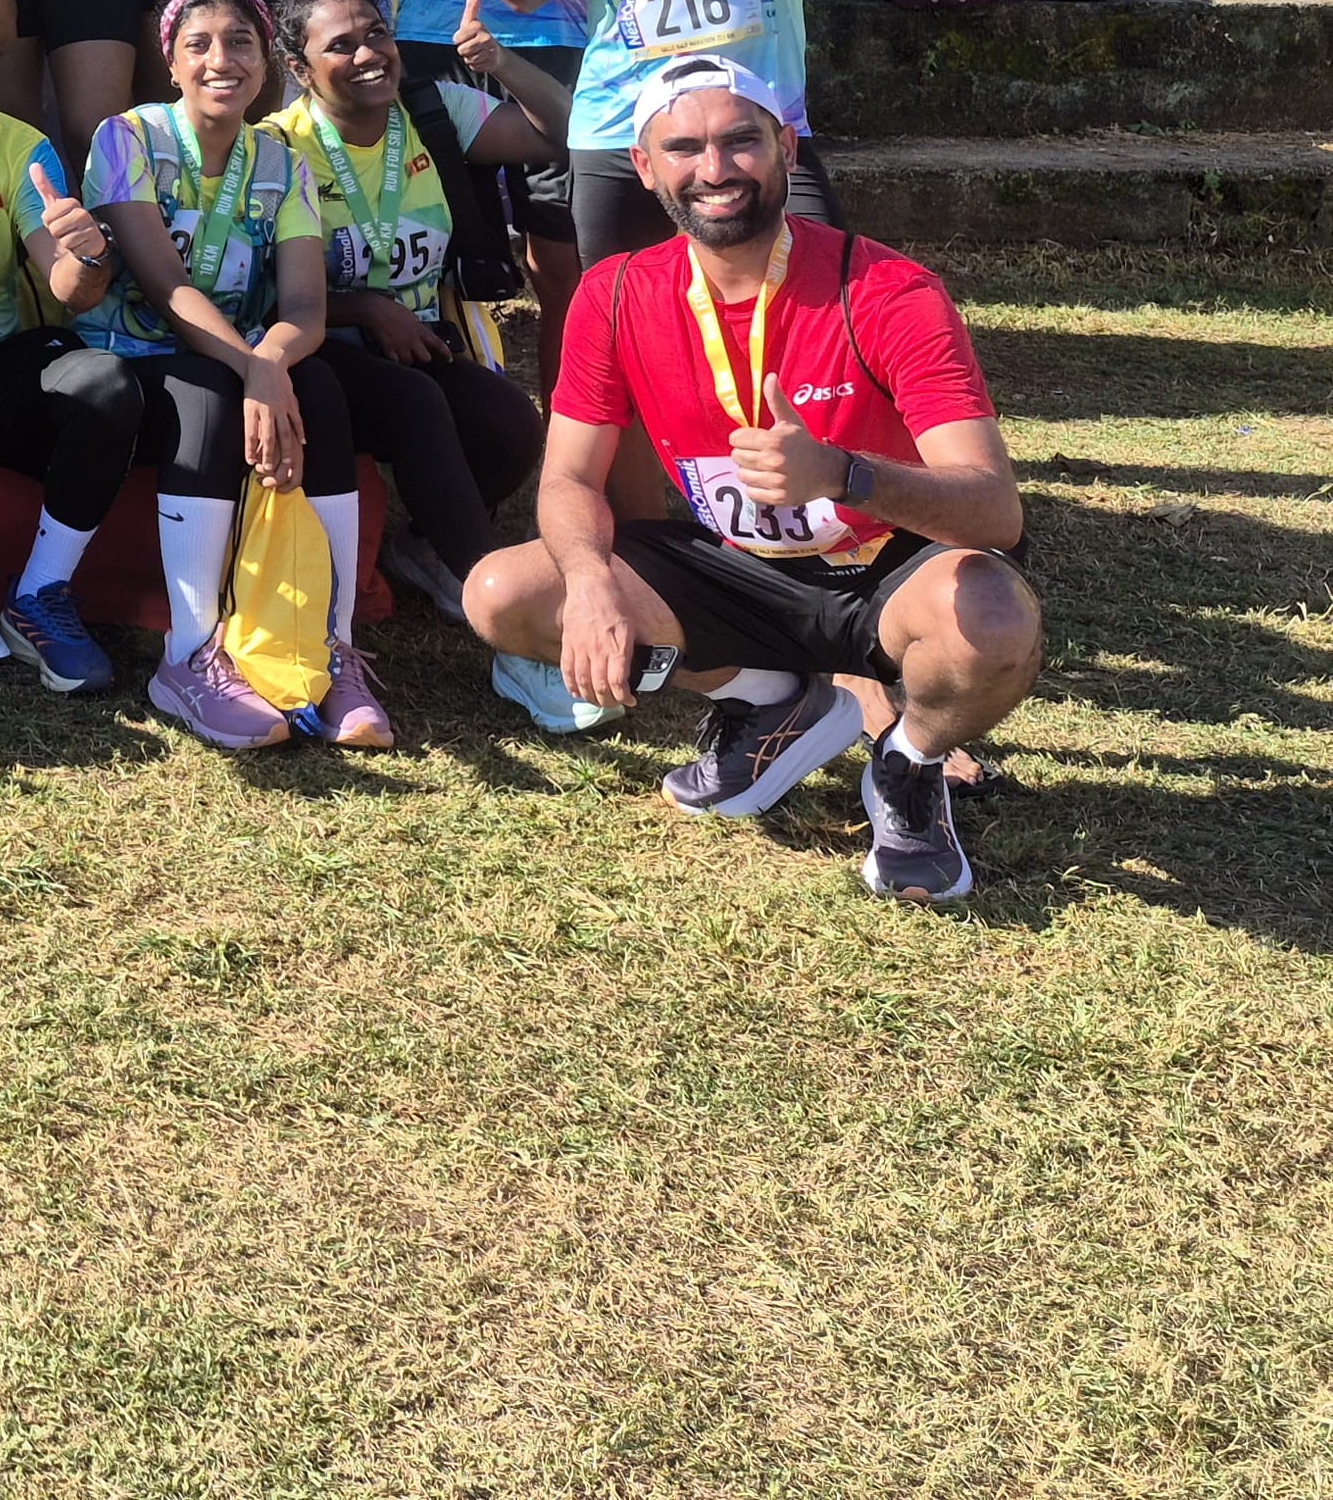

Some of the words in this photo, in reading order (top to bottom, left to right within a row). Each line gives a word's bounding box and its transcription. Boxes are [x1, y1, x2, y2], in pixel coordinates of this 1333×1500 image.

[389, 132, 402, 153] SRI
[230, 154, 244, 173] SRI
[332, 152, 348, 172] FOR
[387, 153, 400, 174] FOR
[222, 172, 239, 198] FOR
[339, 171, 358, 195] RUN
[385, 173, 397, 192] RUN
[215, 198, 232, 216] RUN
[361, 221, 374, 239] KM
[379, 221, 393, 239] KM
[203, 244, 219, 262] KM
[199, 262, 213, 277] 10
[813, 381, 855, 403] asics
[715, 485, 814, 542] 233
